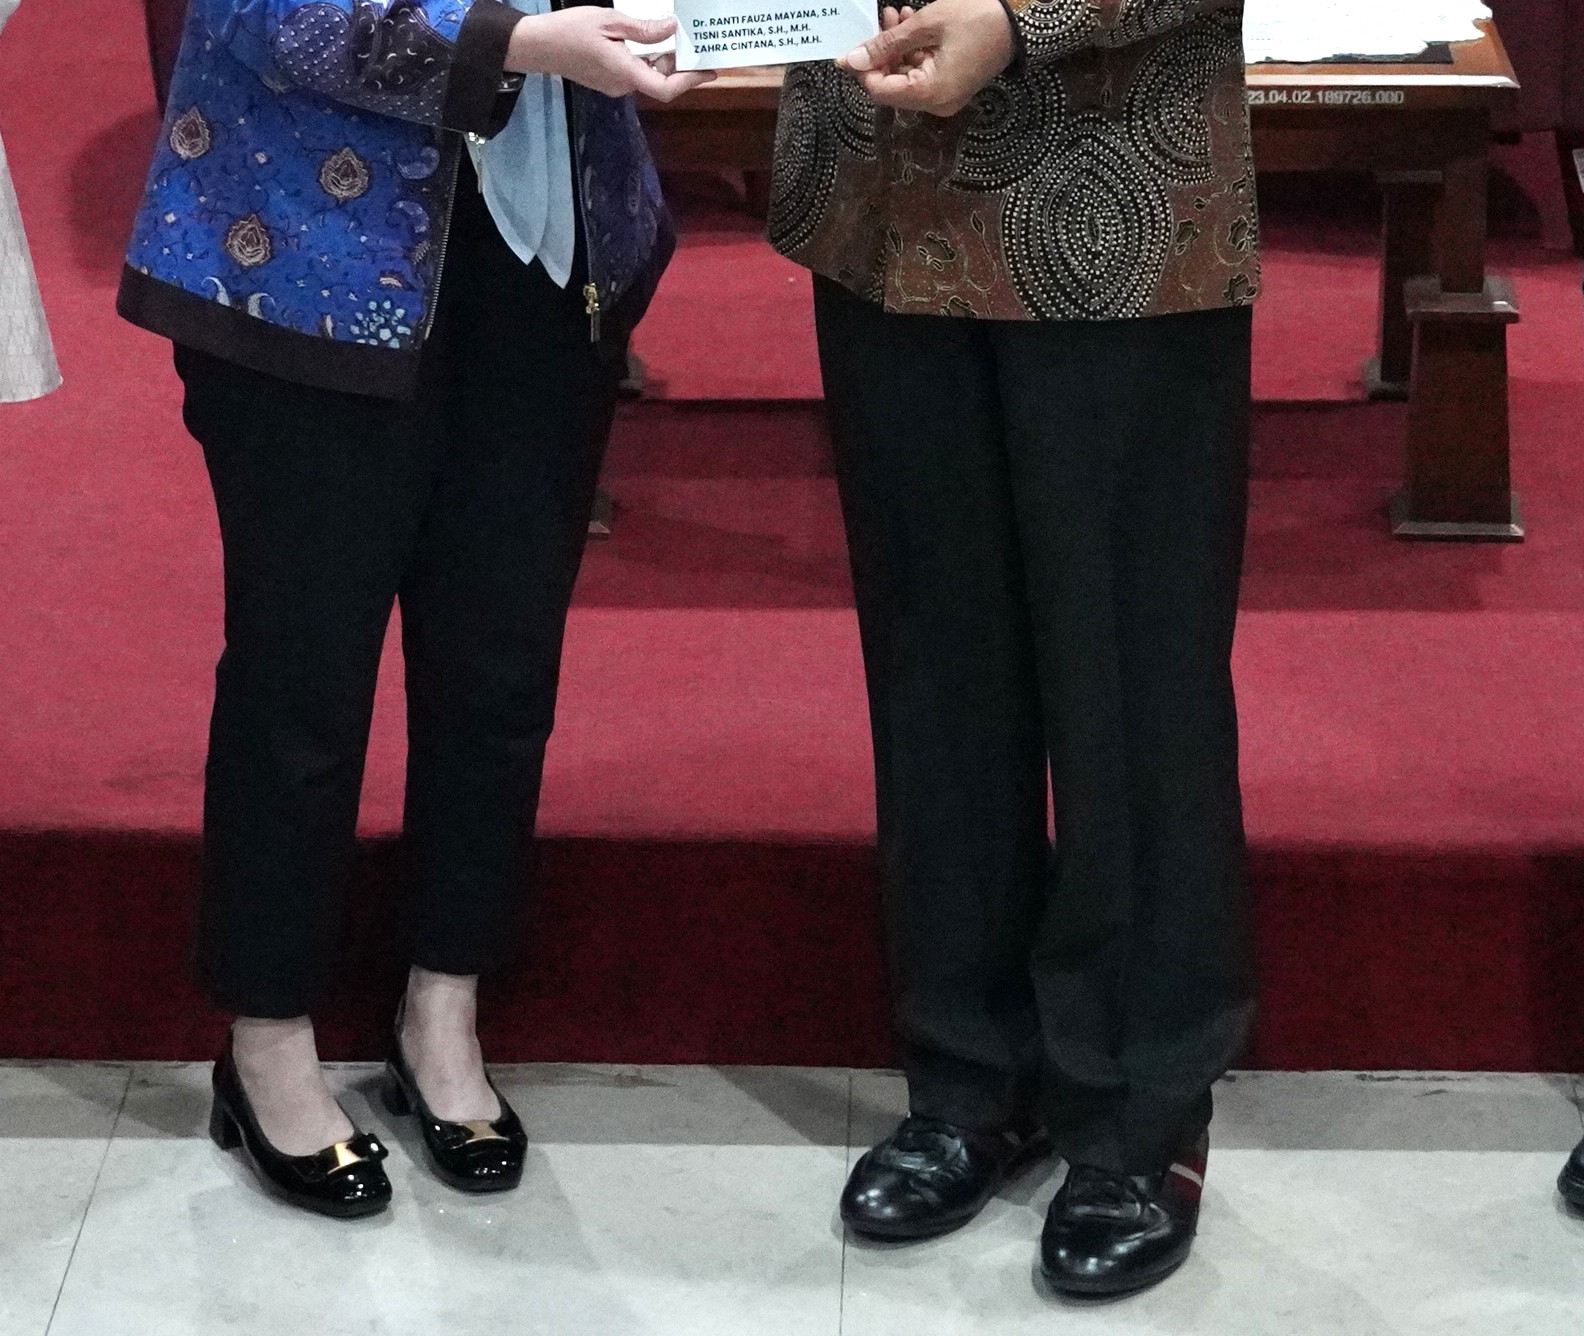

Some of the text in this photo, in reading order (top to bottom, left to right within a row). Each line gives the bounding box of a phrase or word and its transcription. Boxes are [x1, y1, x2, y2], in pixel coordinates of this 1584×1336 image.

[692, 7, 840, 28] Dr. RANTI FAUZA MAYANA, S.H.
[693, 23, 811, 40] TISNI SANTIKA, S.H., M.H.
[693, 35, 822, 54] ZAHRA CINTANA, S.H., M.H.
